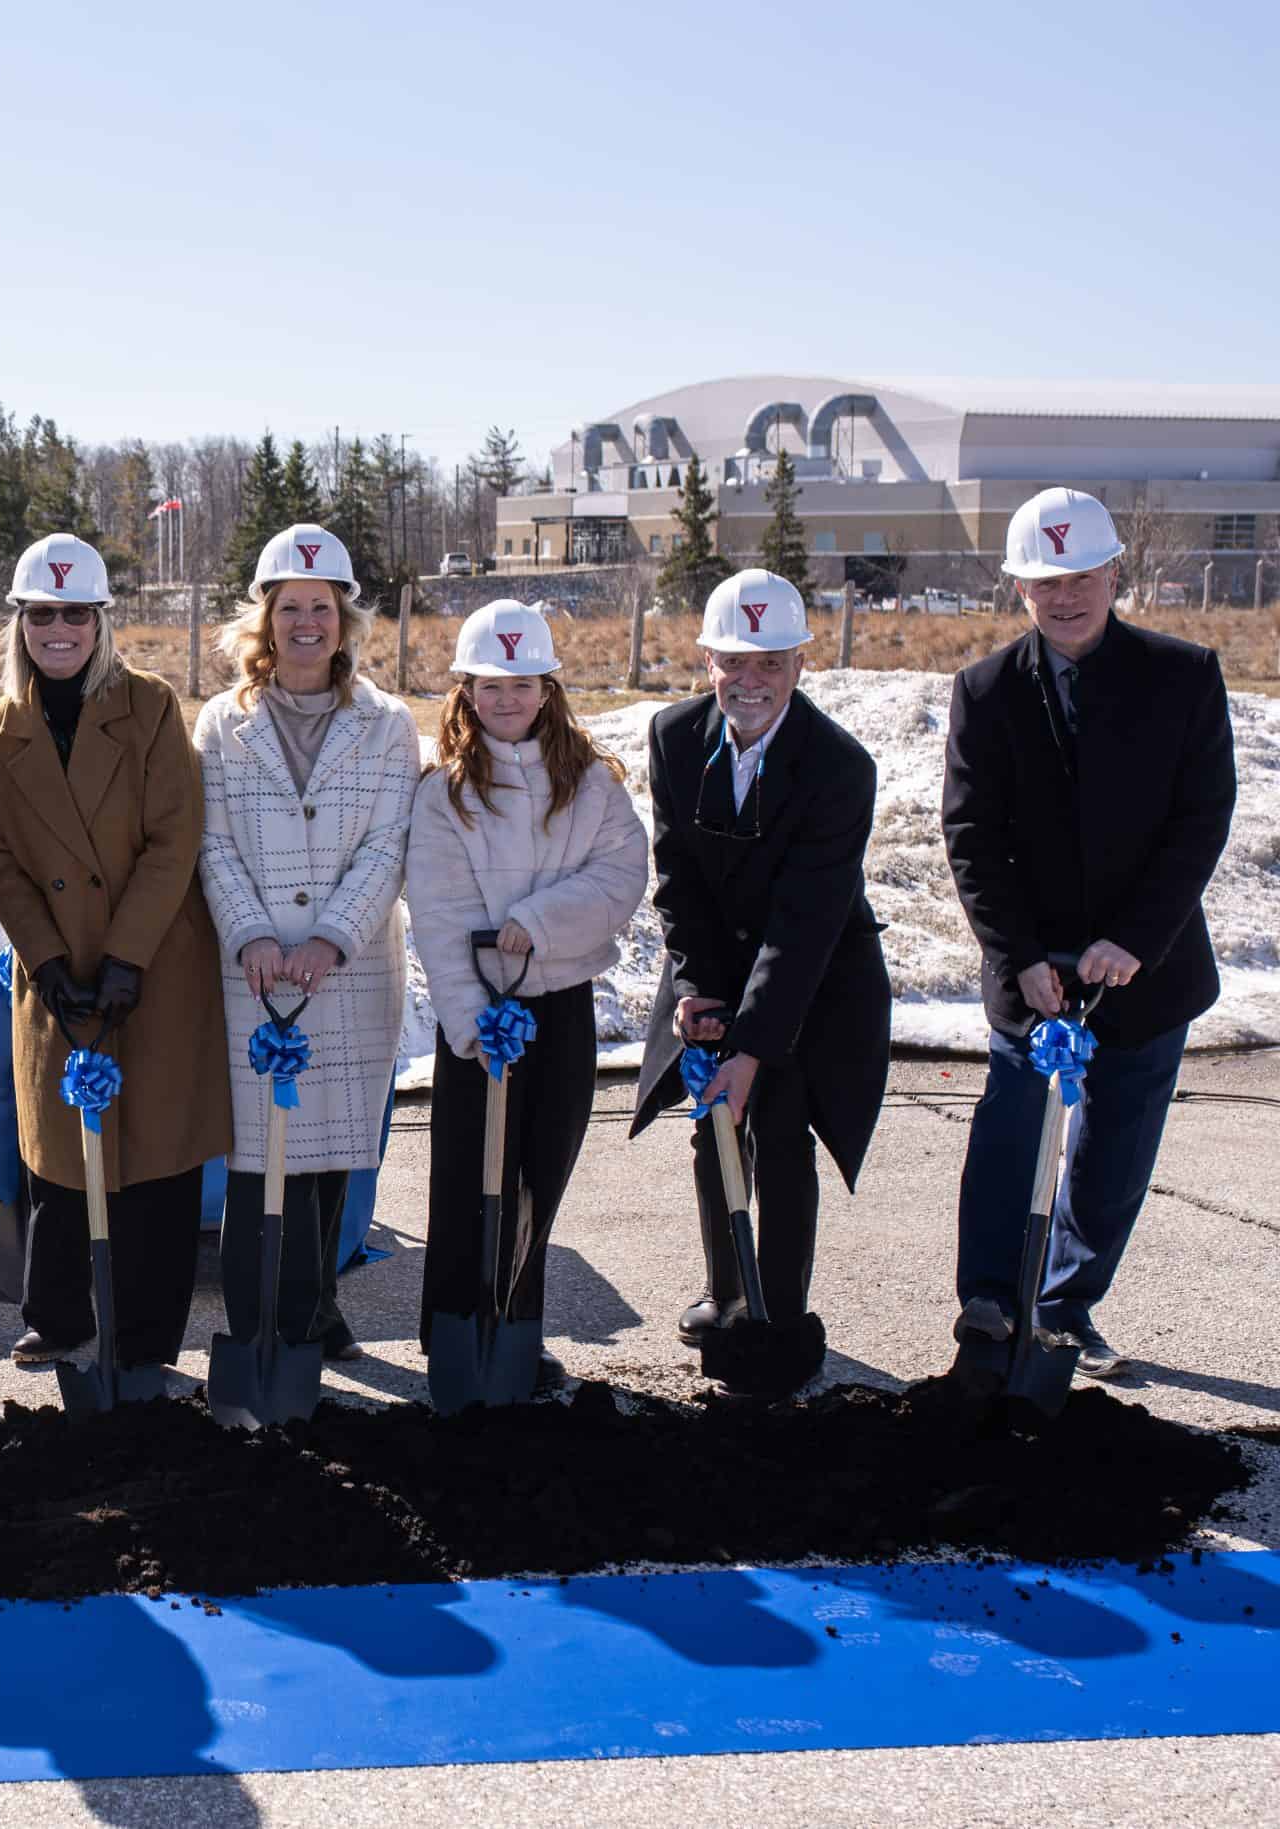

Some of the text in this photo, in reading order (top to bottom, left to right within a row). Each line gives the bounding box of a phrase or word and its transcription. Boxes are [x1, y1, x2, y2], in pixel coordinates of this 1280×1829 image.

[1042, 523, 1070, 555] Y
[296, 545, 321, 569] Y
[48, 563, 73, 589] Y
[741, 603, 768, 633] Y
[496, 633, 522, 661] Y
